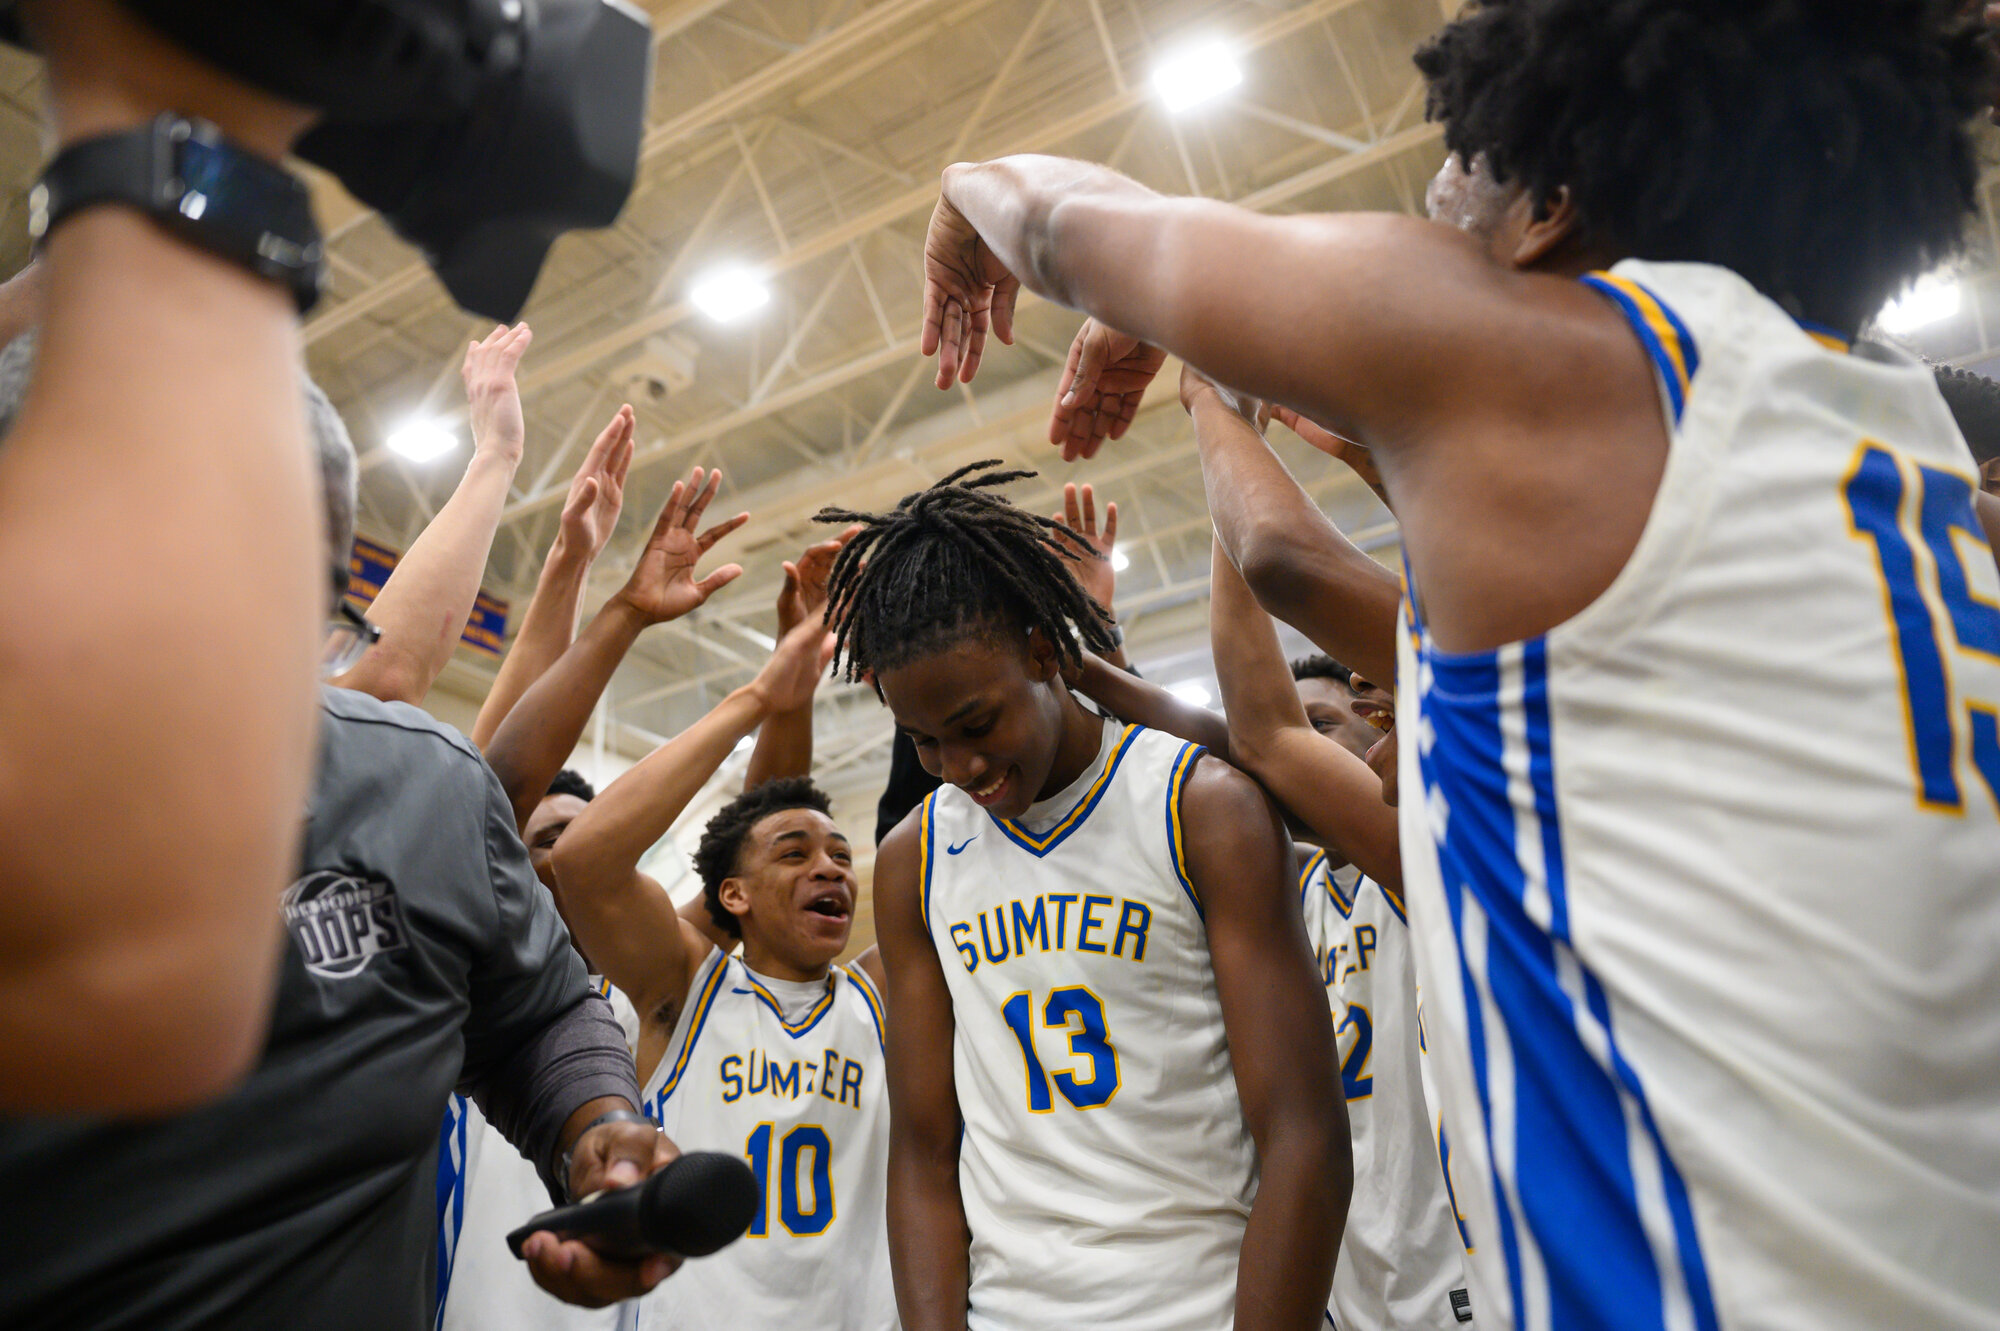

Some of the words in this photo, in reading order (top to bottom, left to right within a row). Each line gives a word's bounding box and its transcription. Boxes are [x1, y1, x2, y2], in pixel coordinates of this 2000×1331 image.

[949, 893, 1153, 975] SUMTER
[719, 1048, 864, 1110] SUMTER
[1000, 984, 1122, 1114] 13
[1332, 1001, 1373, 1103] 2
[744, 1121, 837, 1238] 10
